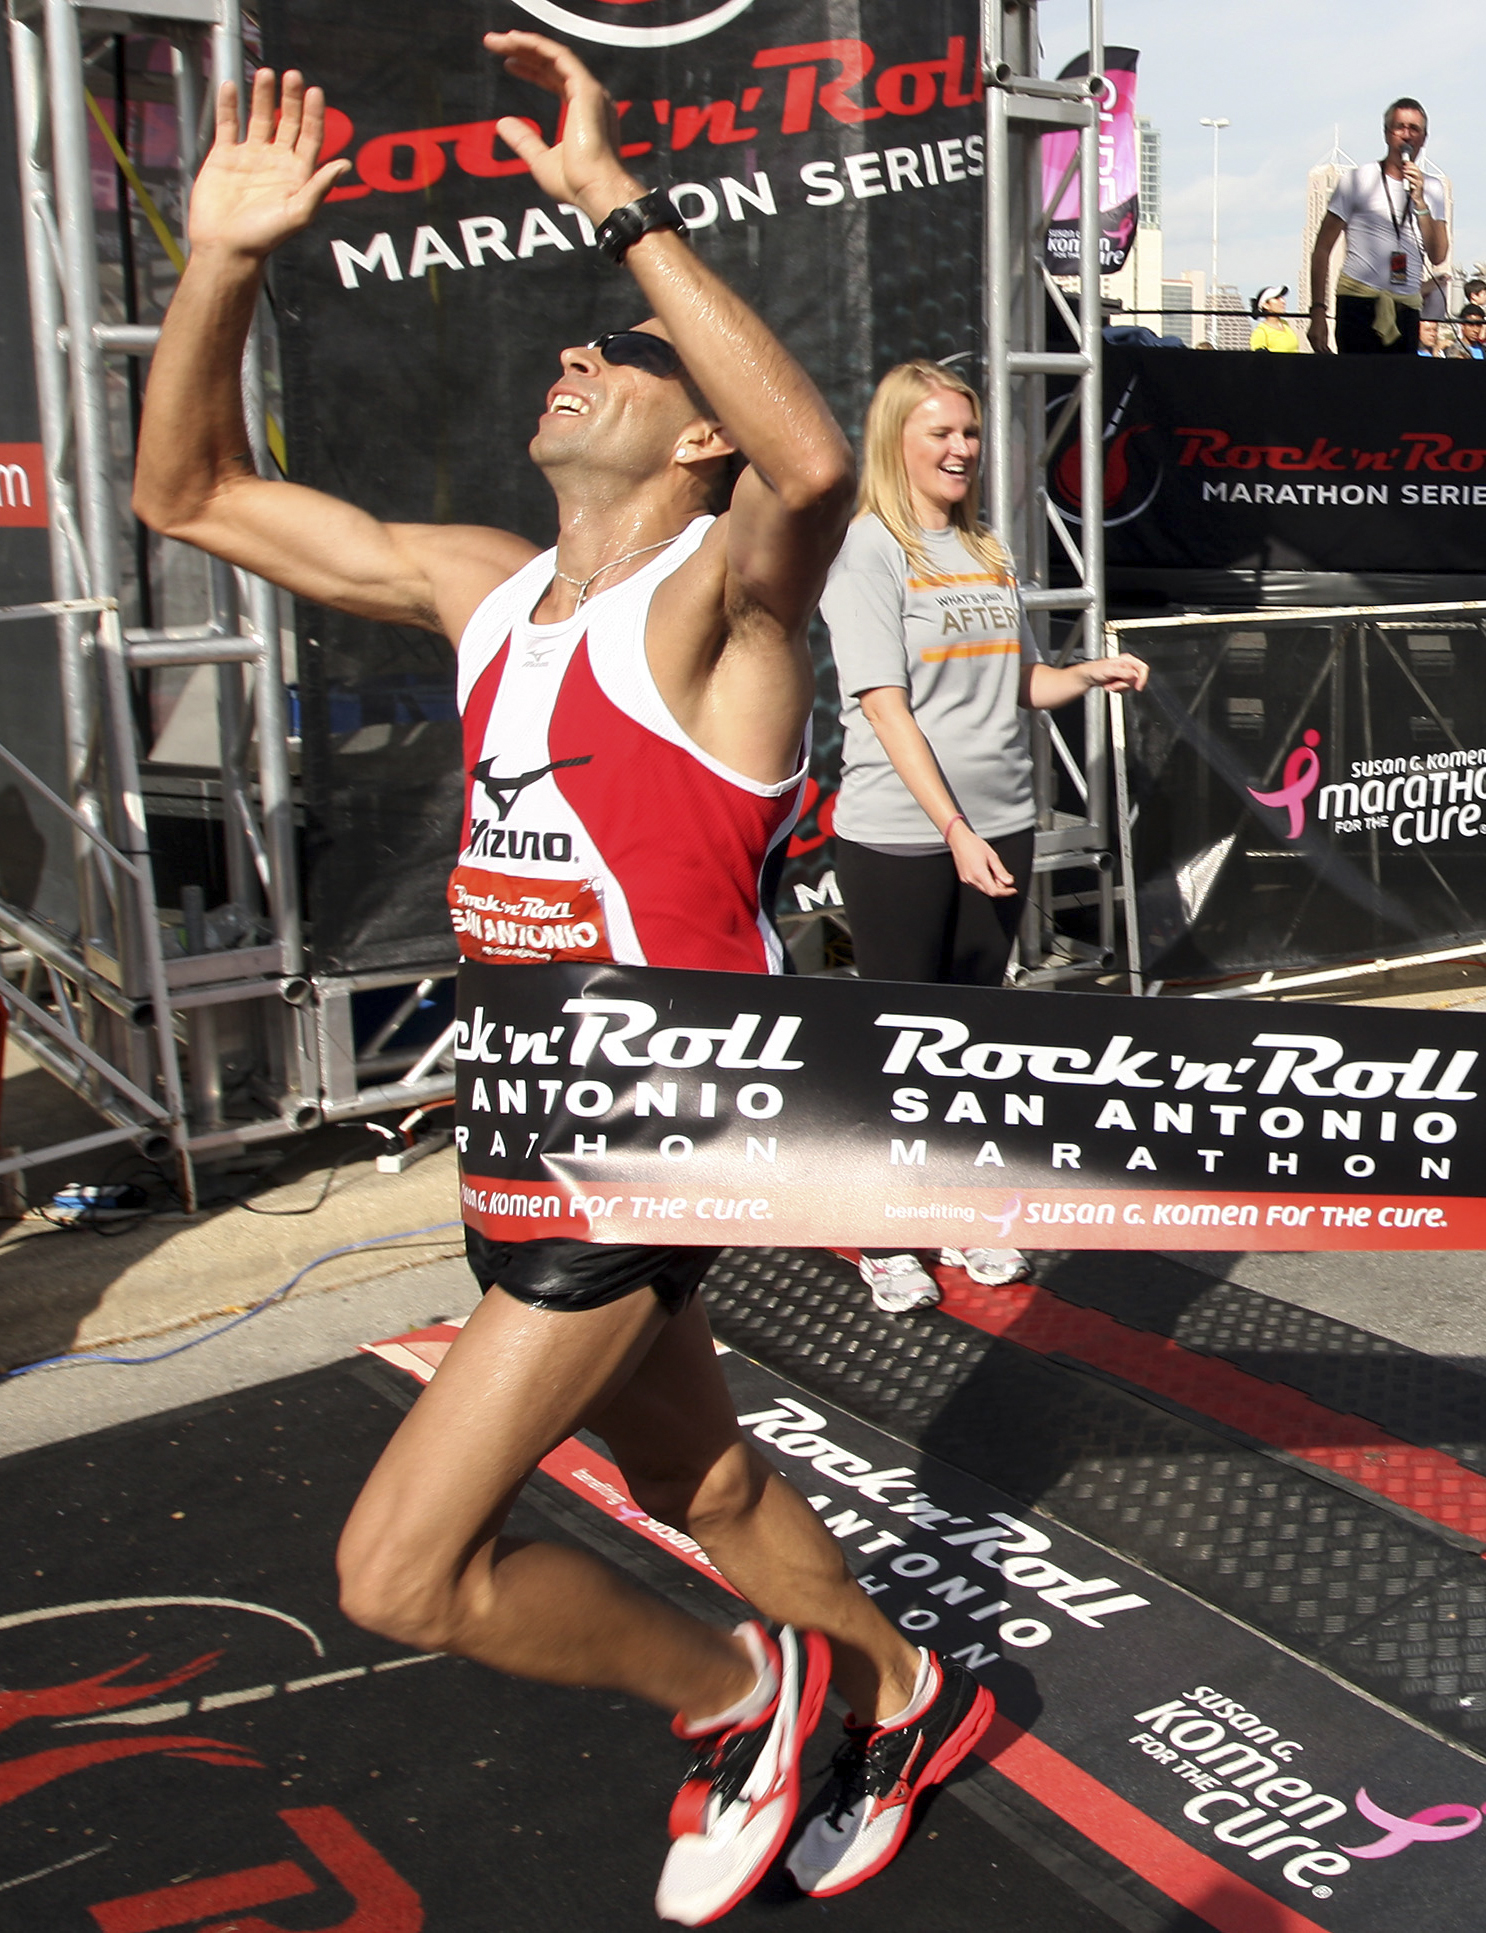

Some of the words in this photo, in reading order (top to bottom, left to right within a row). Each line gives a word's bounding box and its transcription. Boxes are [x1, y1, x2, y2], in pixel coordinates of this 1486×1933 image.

[330, 170, 778, 290] MARATON
[800, 134, 985, 207] SERIES
[1173, 427, 1346, 471] Rock
[1202, 481, 1389, 506] MARATHON
[1334, 819, 1362, 834] FOR
[1363, 816, 1389, 830] THE
[483, 918, 599, 949] ANTONIO
[561, 998, 805, 1070] Roll
[873, 1013, 1165, 1089] Rock
[1251, 1032, 1479, 1102] Roll
[471, 1077, 785, 1120] ANTONIO
[890, 1086, 1045, 1127] SAN
[1094, 1098, 1459, 1145] ANTONIO
[889, 1138, 1452, 1181] MARATHON
[884, 1203, 976, 1222] benefiting
[1123, 1204, 1147, 1225] G.
[737, 1397, 916, 1503] Rock
[941, 1511, 1152, 1629] Roll
[807, 1494, 1053, 1649] ANTONIO
[1128, 1732, 1176, 1765] FOR
[1171, 1759, 1224, 1793] THE
